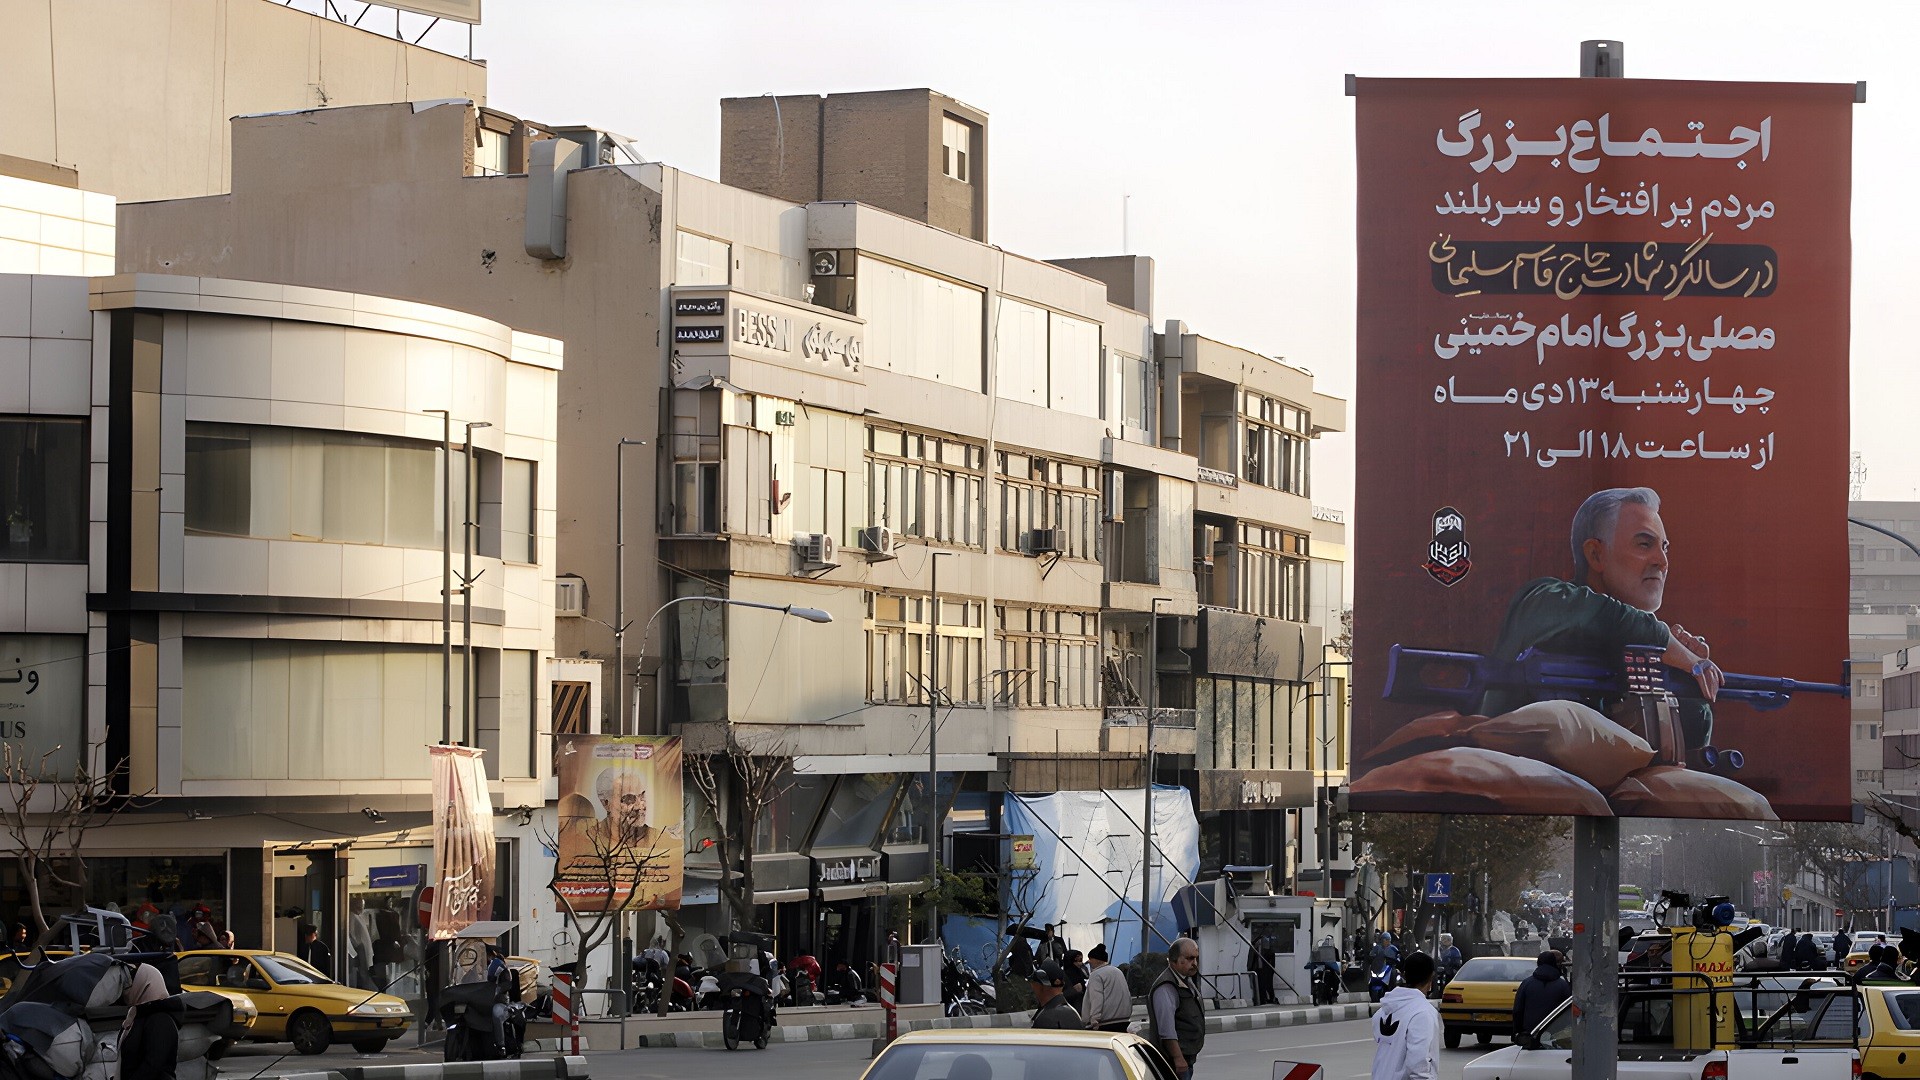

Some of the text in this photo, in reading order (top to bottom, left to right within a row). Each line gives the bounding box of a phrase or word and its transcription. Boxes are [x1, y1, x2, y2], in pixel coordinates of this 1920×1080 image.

[1436, 108, 1772, 174] اجتماع بزرگ
[1435, 181, 1775, 236] مردم پر افتخار و سربلند
[1428, 231, 1774, 301] در سالگرد شهادت حاج قاسم سلیمانی
[1434, 310, 1776, 366] مصلی بزرگ امام خمینی
[1434, 375, 1776, 416] چهارشنبه ۱۳ دی ماه
[1503, 429, 1775, 471] از ساعت ۱۸ الی ۲۱
